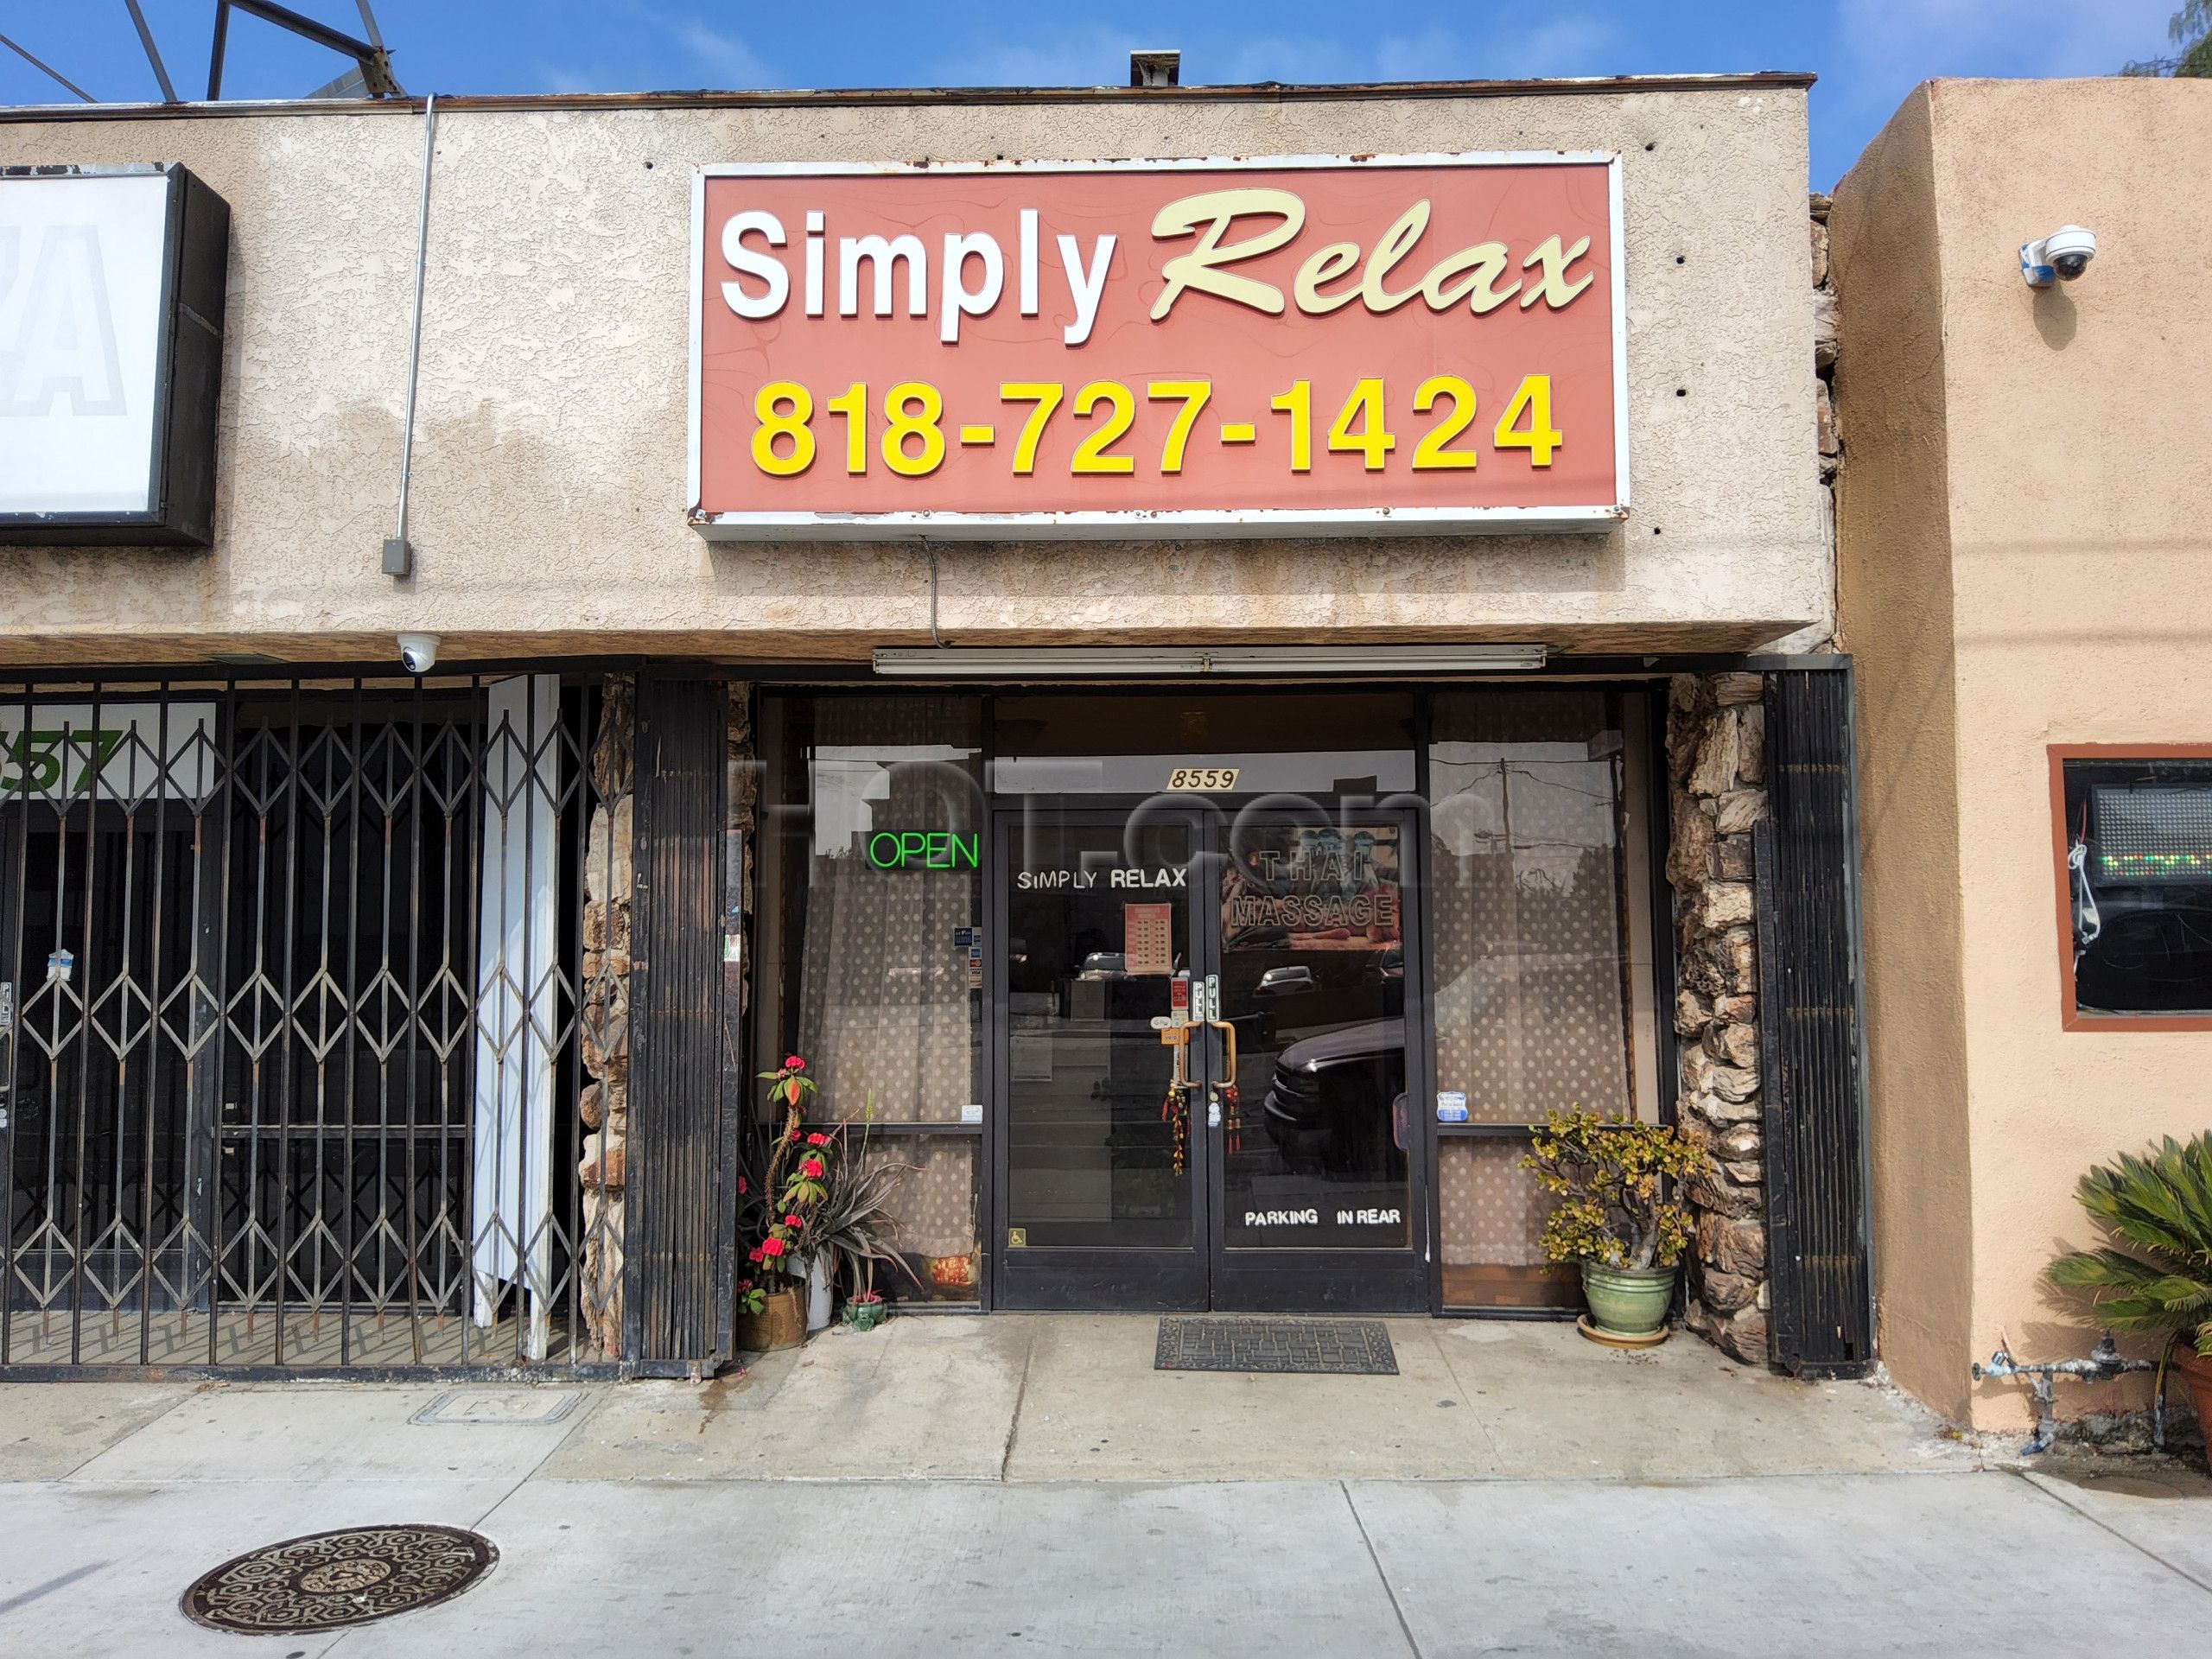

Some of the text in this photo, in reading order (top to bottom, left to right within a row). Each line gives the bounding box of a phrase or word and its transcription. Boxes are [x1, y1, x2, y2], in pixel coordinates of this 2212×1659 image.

[720, 188, 1595, 346] Simply Relax
[751, 374, 1563, 477] 818-727-1424
[1172, 770, 1235, 788] 8559
[869, 832, 978, 868] OPEN
[1259, 850, 1363, 881] THAI
[1017, 868, 1187, 889] SIMPLY RELAX
[1230, 895, 1395, 927] MASSAGE
[1208, 976, 1217, 1020] PULL
[1244, 1208, 1402, 1226] PARKING IN REAR
